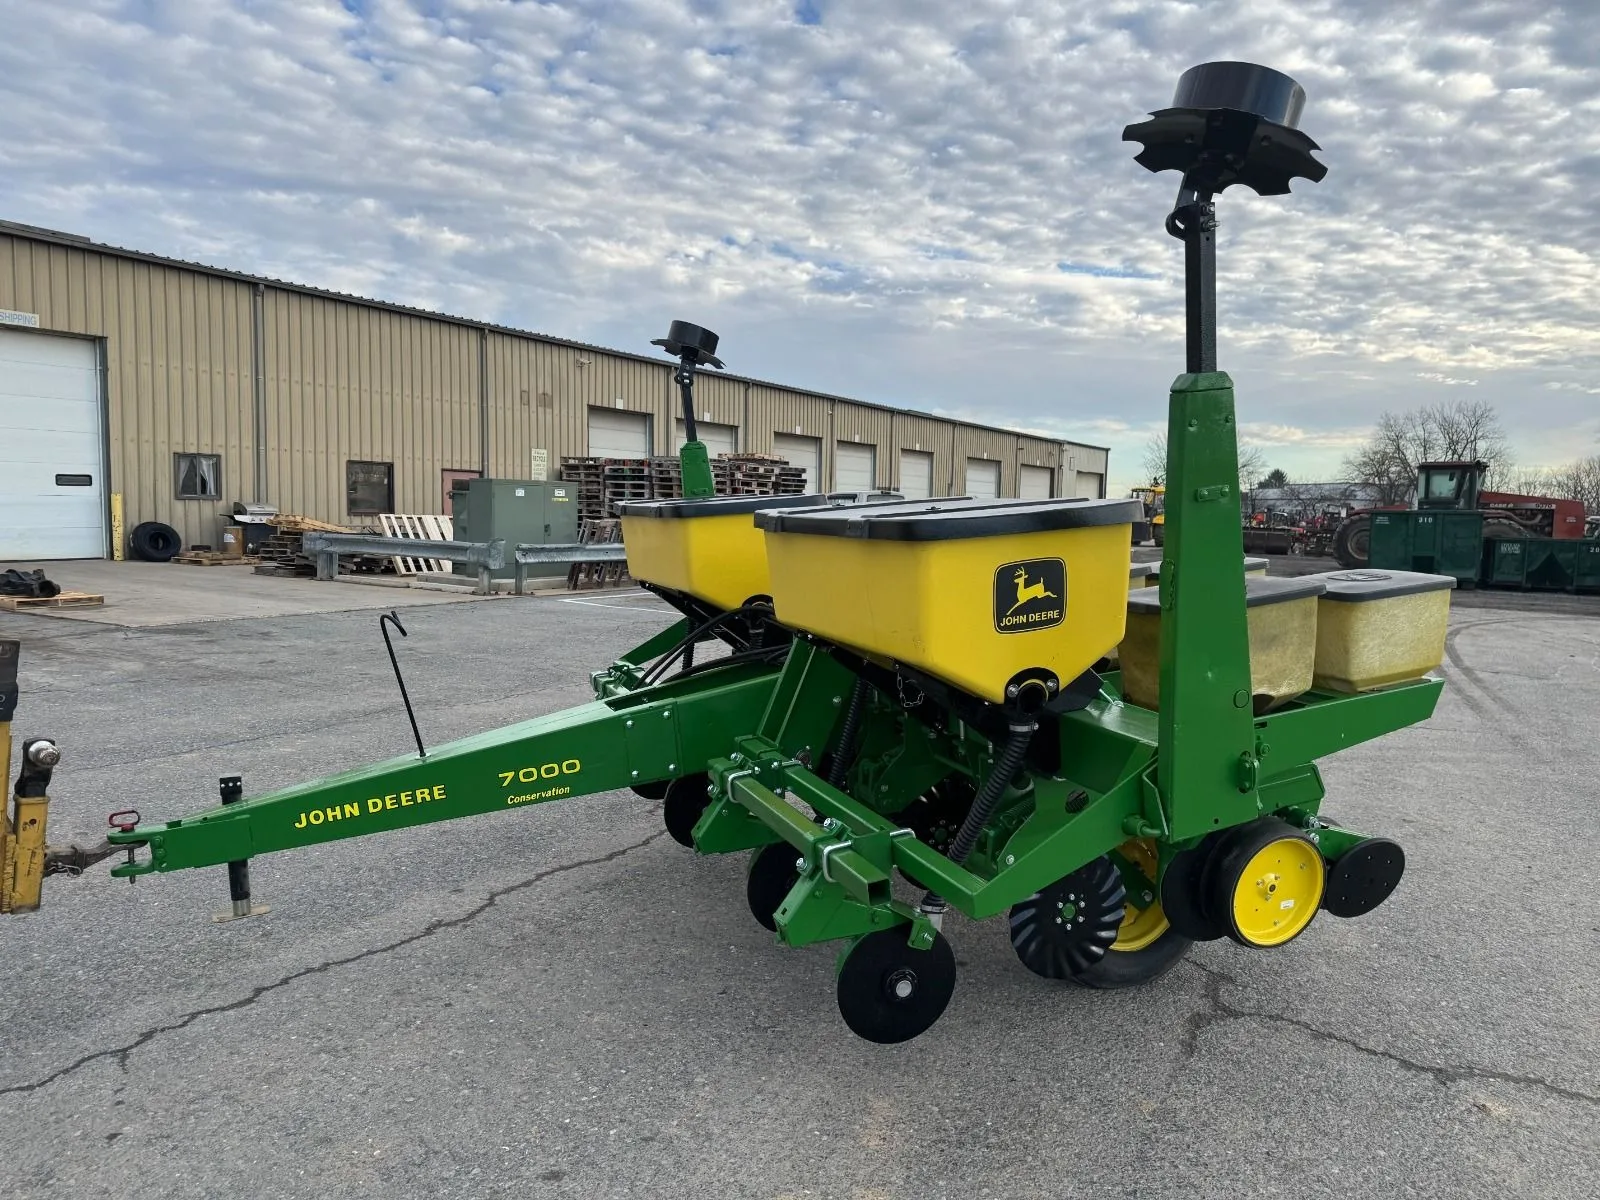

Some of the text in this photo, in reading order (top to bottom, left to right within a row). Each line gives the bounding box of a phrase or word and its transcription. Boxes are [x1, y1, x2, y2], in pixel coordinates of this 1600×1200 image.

[0, 311, 37, 326] SHIPPING
[1418, 516, 1433, 524] 310
[1000, 609, 1060, 627] JOHN DEERE
[498, 759, 581, 787] 7000
[507, 786, 570, 805] Conservation
[294, 784, 447, 829] JOHN DEERE
